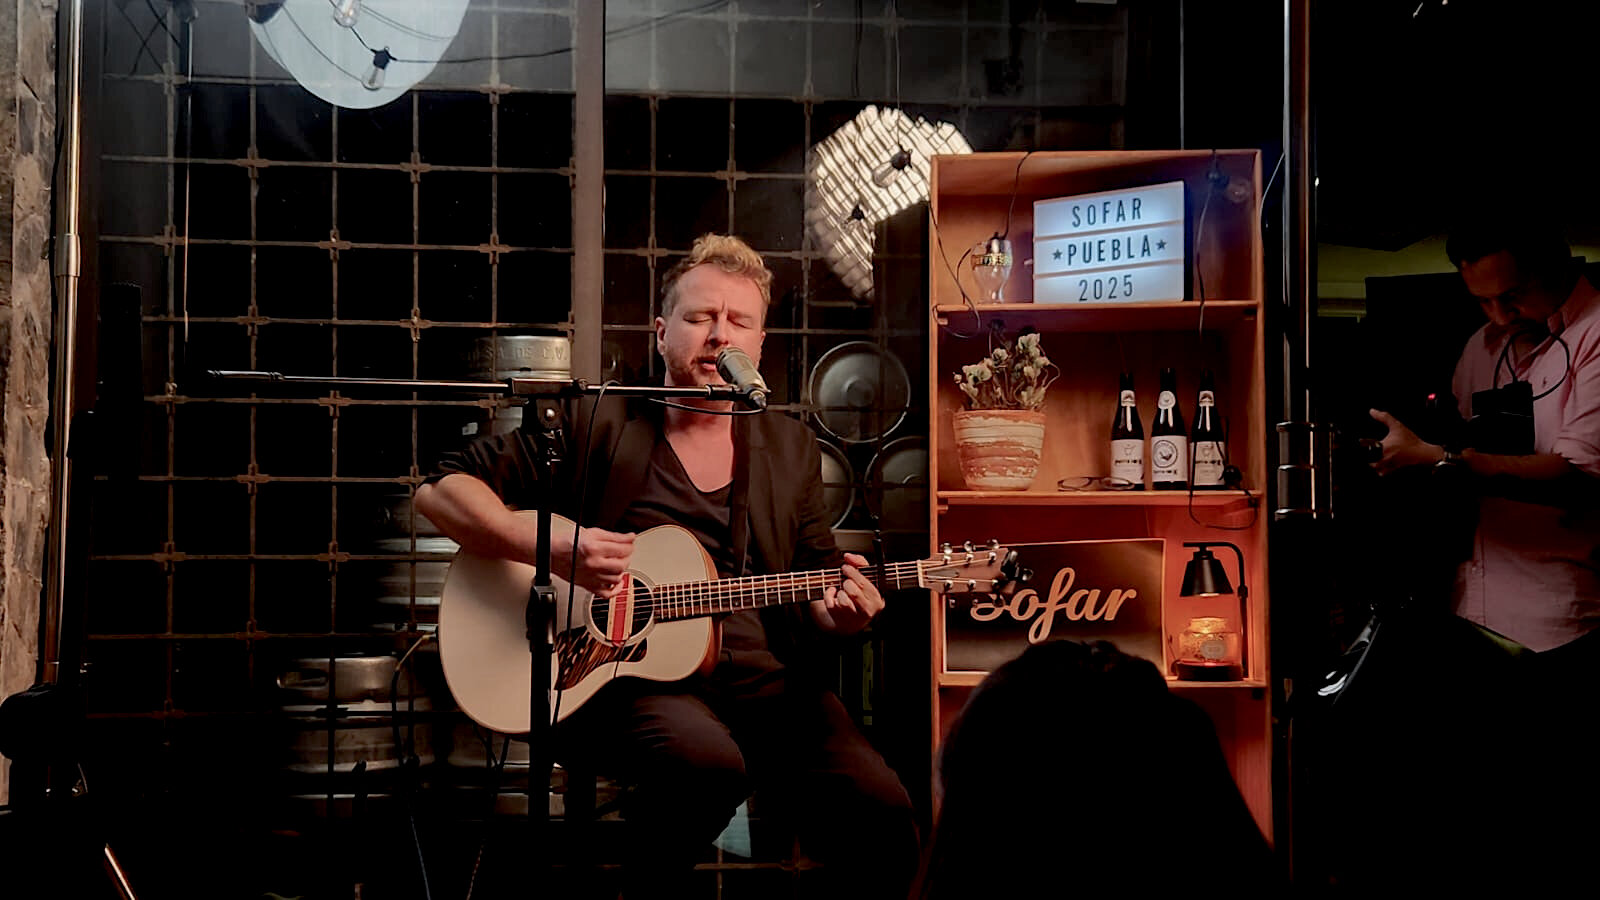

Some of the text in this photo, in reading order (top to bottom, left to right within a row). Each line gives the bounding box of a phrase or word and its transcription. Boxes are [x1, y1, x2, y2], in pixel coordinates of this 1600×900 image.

[1072, 197, 1142, 228] SOFAR
[1067, 234, 1151, 266] PUEBLA
[1078, 274, 1133, 301] 2025
